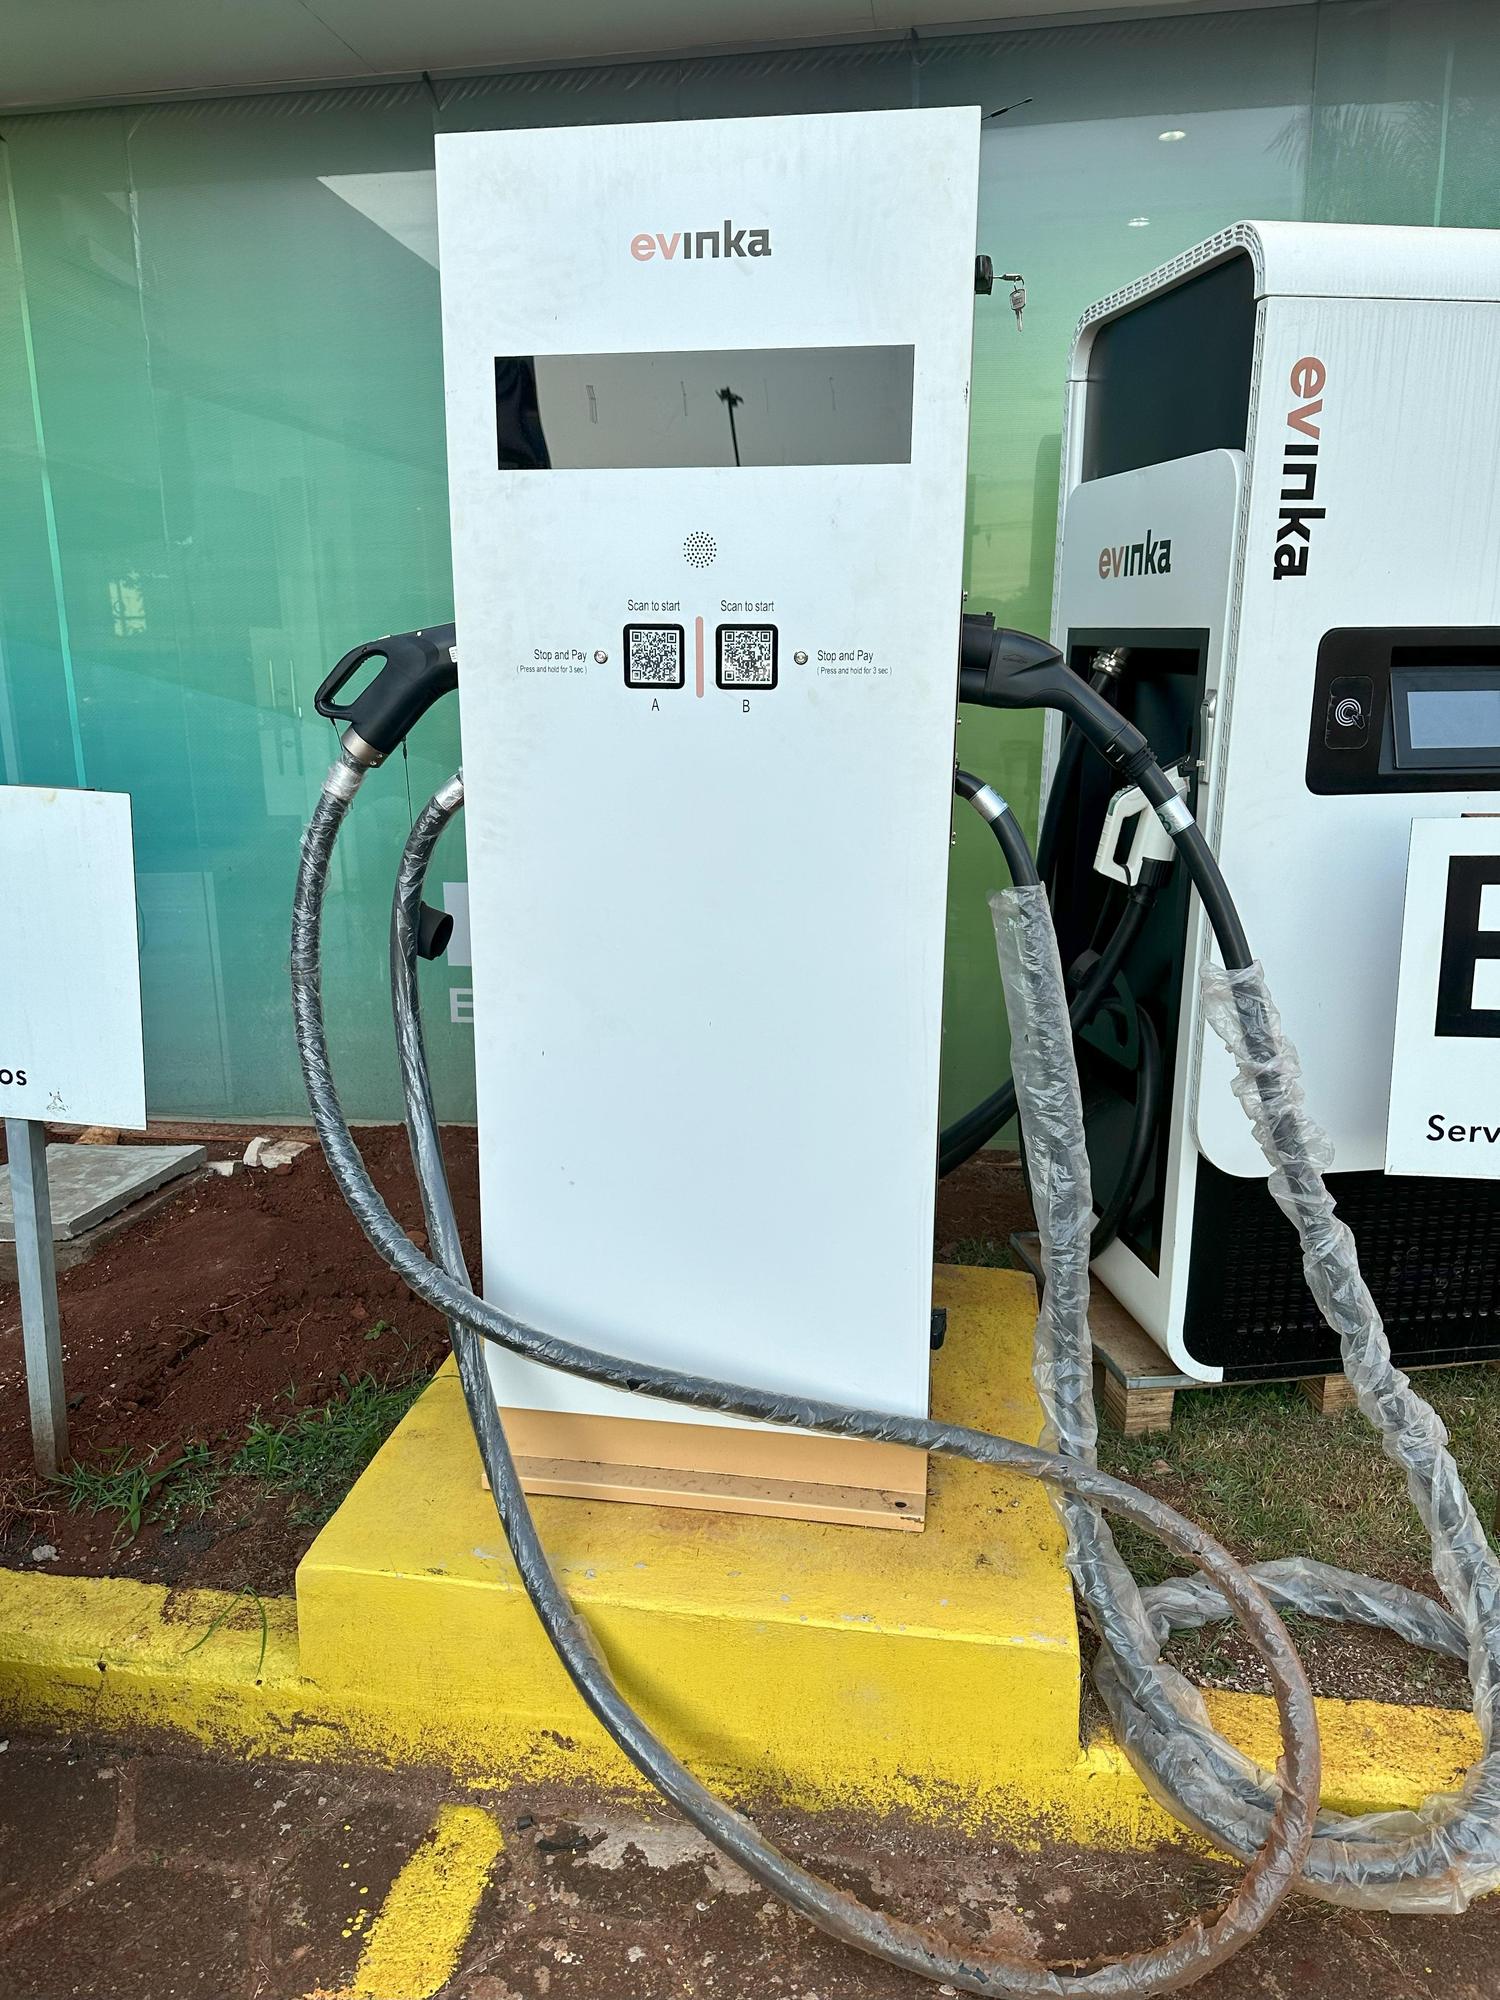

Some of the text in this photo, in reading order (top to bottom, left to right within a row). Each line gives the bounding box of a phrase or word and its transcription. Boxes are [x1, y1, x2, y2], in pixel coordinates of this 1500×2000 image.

[630, 219, 772, 262] evinka
[1272, 356, 1327, 581] evinka
[1098, 529, 1172, 580] evinka
[627, 599, 681, 612] Scan to start
[720, 599, 775, 612] Scan to start
[533, 648, 587, 663] Stop and Pay
[817, 649, 874, 664] Stop and Pay
[547, 665, 560, 673] hold
[560, 665, 568, 673] for
[838, 667, 849, 675] and
[849, 666, 863, 675] hold
[863, 666, 871, 675] for
[651, 697, 660, 712] A
[742, 699, 751, 713] B
[1426, 1114, 1500, 1143] Serv
